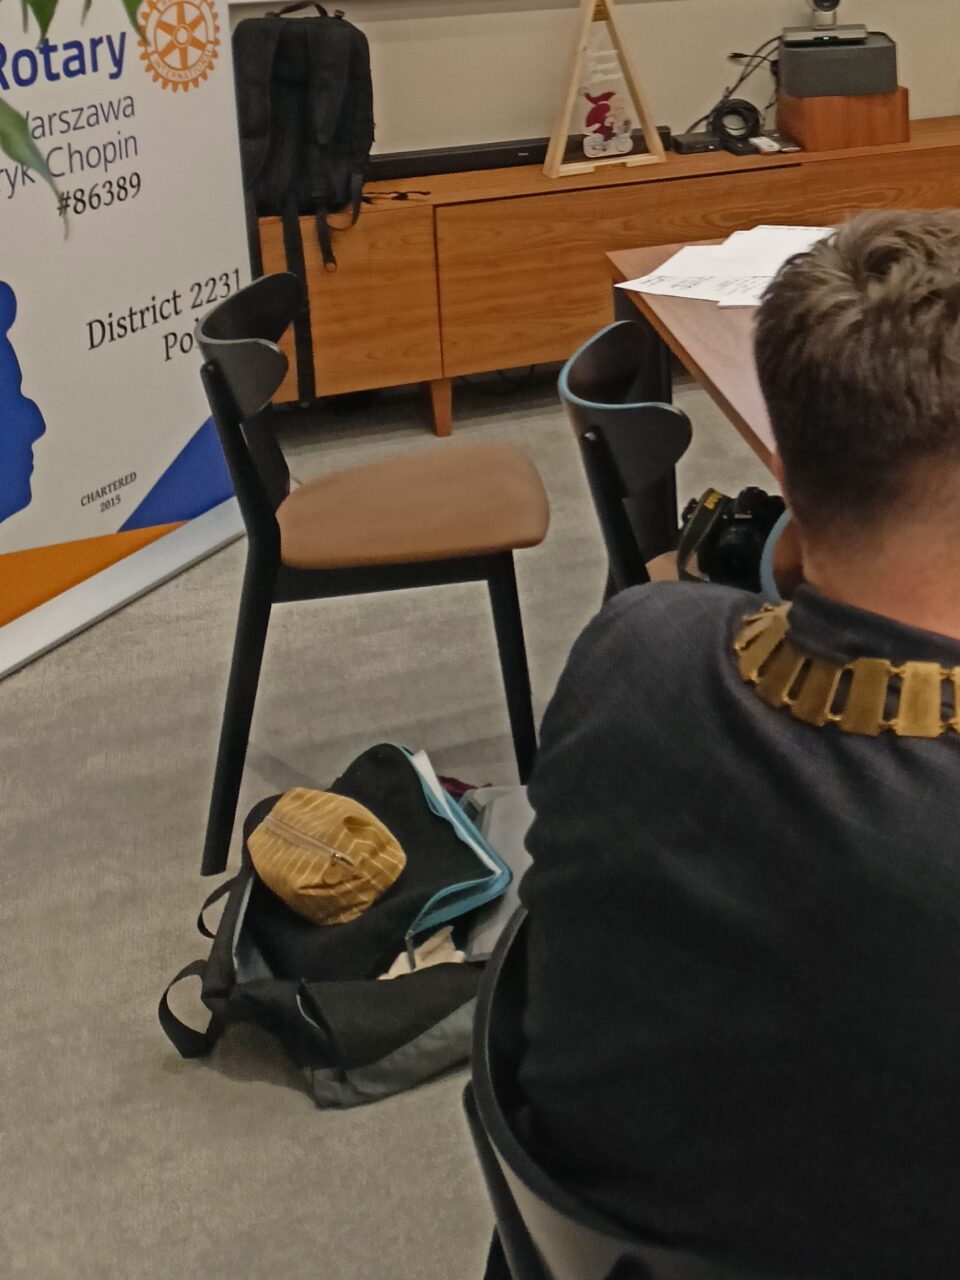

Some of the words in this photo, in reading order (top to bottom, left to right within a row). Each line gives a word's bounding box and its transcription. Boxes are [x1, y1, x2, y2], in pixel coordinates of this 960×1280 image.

[24, 95, 136, 140] arszawa
[45, 130, 139, 178] Chopin
[56, 171, 142, 217] #86389
[86, 289, 183, 351] District
[190, 267, 241, 310] 2231
[80, 471, 137, 507] CHARTERED
[100, 493, 122, 513] 2015
